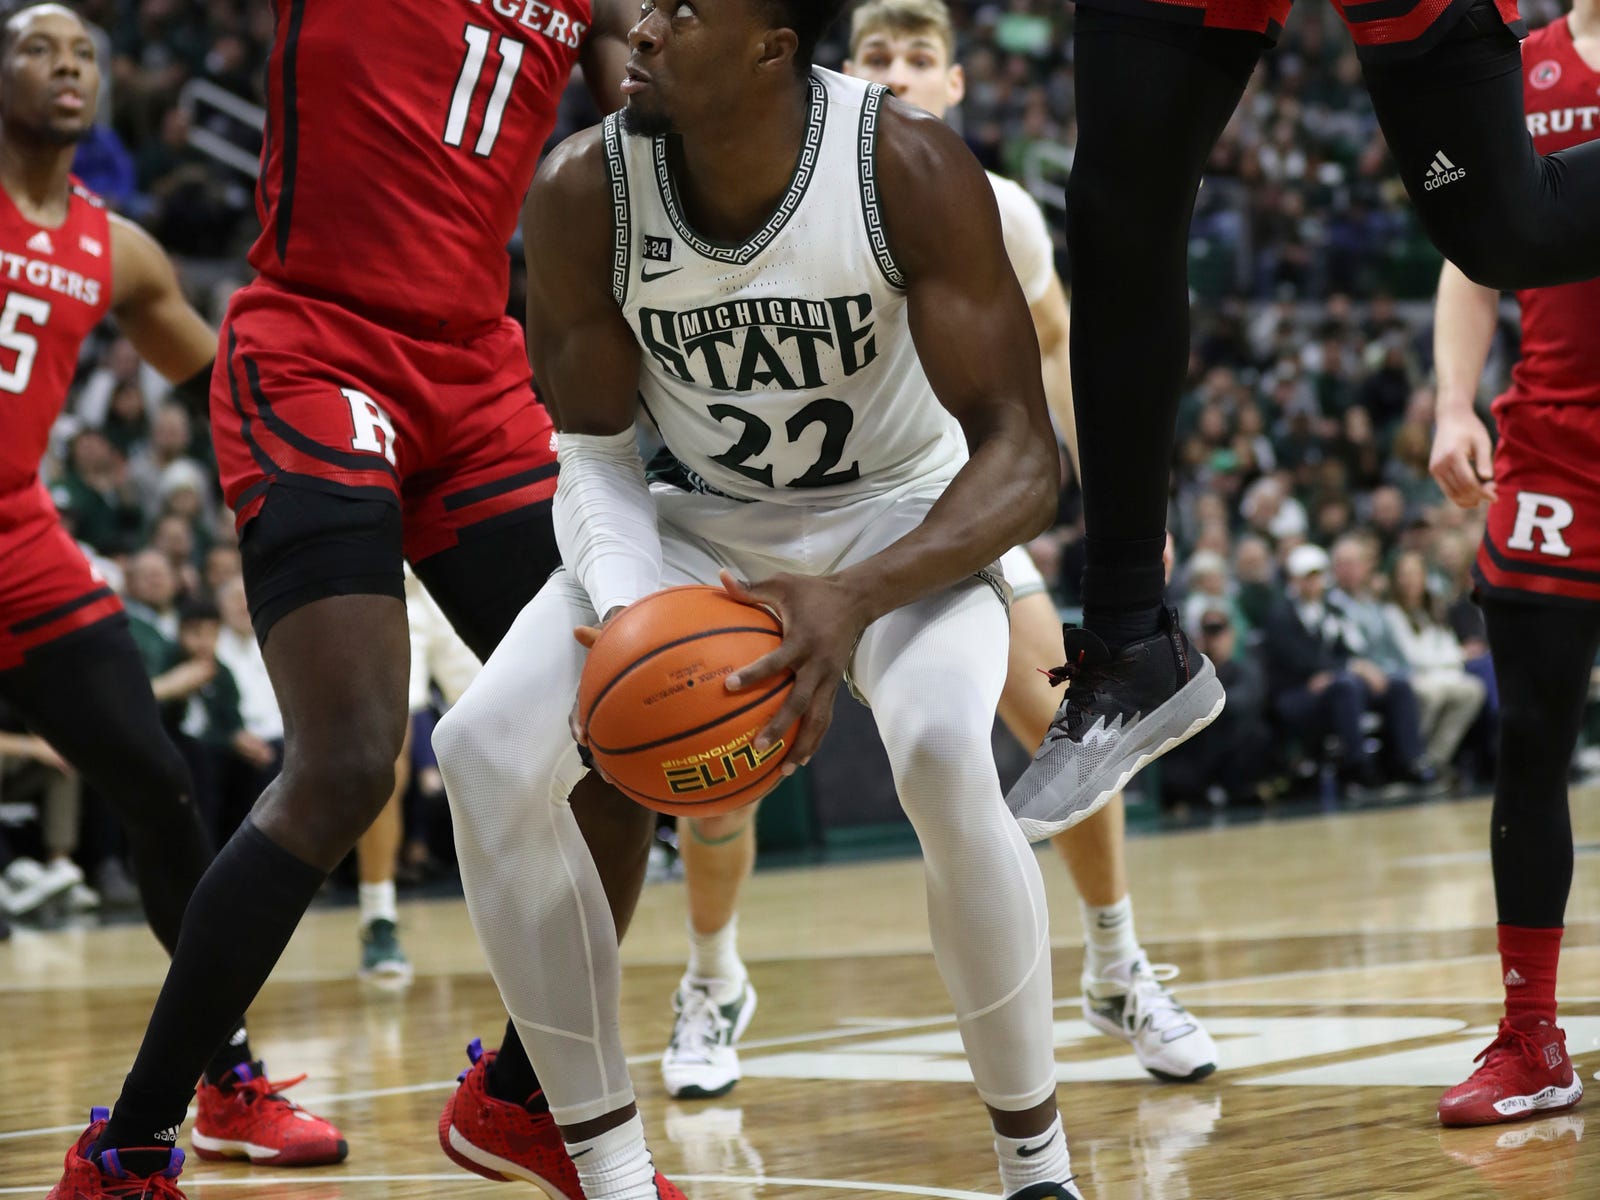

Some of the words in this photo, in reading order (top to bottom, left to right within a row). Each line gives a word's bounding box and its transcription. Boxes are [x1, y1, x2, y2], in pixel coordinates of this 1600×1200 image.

[443, 22, 525, 159] 11
[1526, 105, 1600, 138] RUT
[1424, 167, 1466, 191] adidas
[0, 249, 101, 306] TGERS
[0, 291, 50, 394] 5
[638, 294, 879, 391] STATE
[681, 299, 826, 340] MICHIGAN
[340, 387, 397, 467] R
[707, 398, 860, 488] 22
[1506, 491, 1575, 557] R
